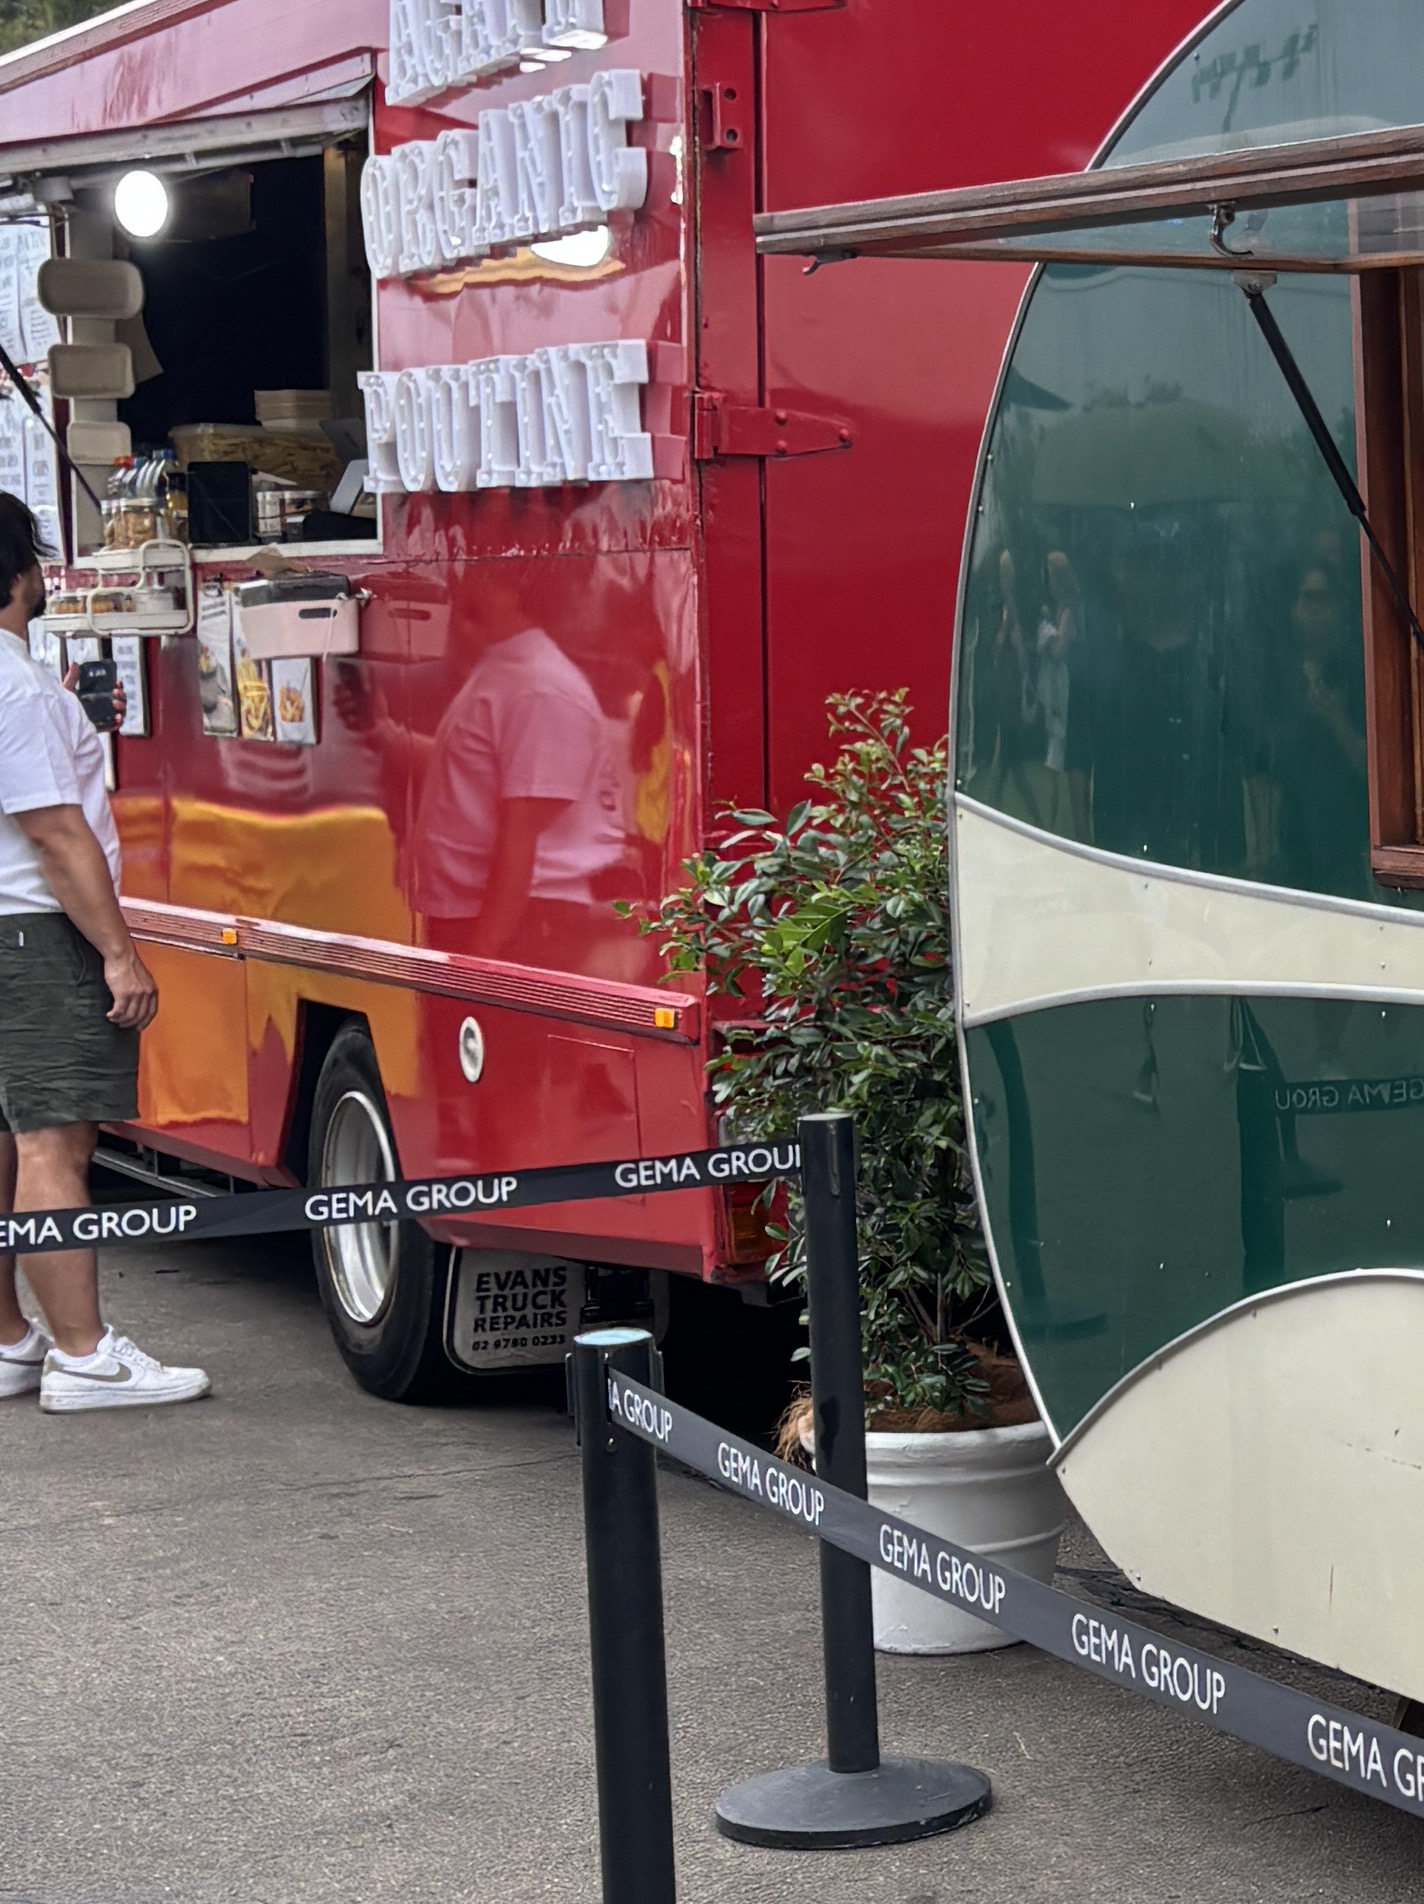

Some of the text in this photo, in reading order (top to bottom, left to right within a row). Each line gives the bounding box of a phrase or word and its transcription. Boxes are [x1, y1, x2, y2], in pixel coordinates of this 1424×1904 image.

[361, 69, 647, 279] ORGANIC
[358, 339, 654, 493] POUTINE
[304, 1177, 518, 1220] GEMA GROUP
[615, 1157, 700, 1188] GEMA
[72, 1205, 197, 1240] GROUP
[475, 1289, 566, 1315] TRUCK
[476, 1266, 567, 1293] EVANS
[473, 1310, 567, 1333] REPAIRS
[624, 1389, 672, 1443] GROUP
[717, 1442, 825, 1527] GEMA GROUP
[879, 1524, 1006, 1614] GEMA GROUP
[1071, 1612, 1226, 1714] GEMA GROUP
[1307, 1713, 1387, 1787] GEMA
